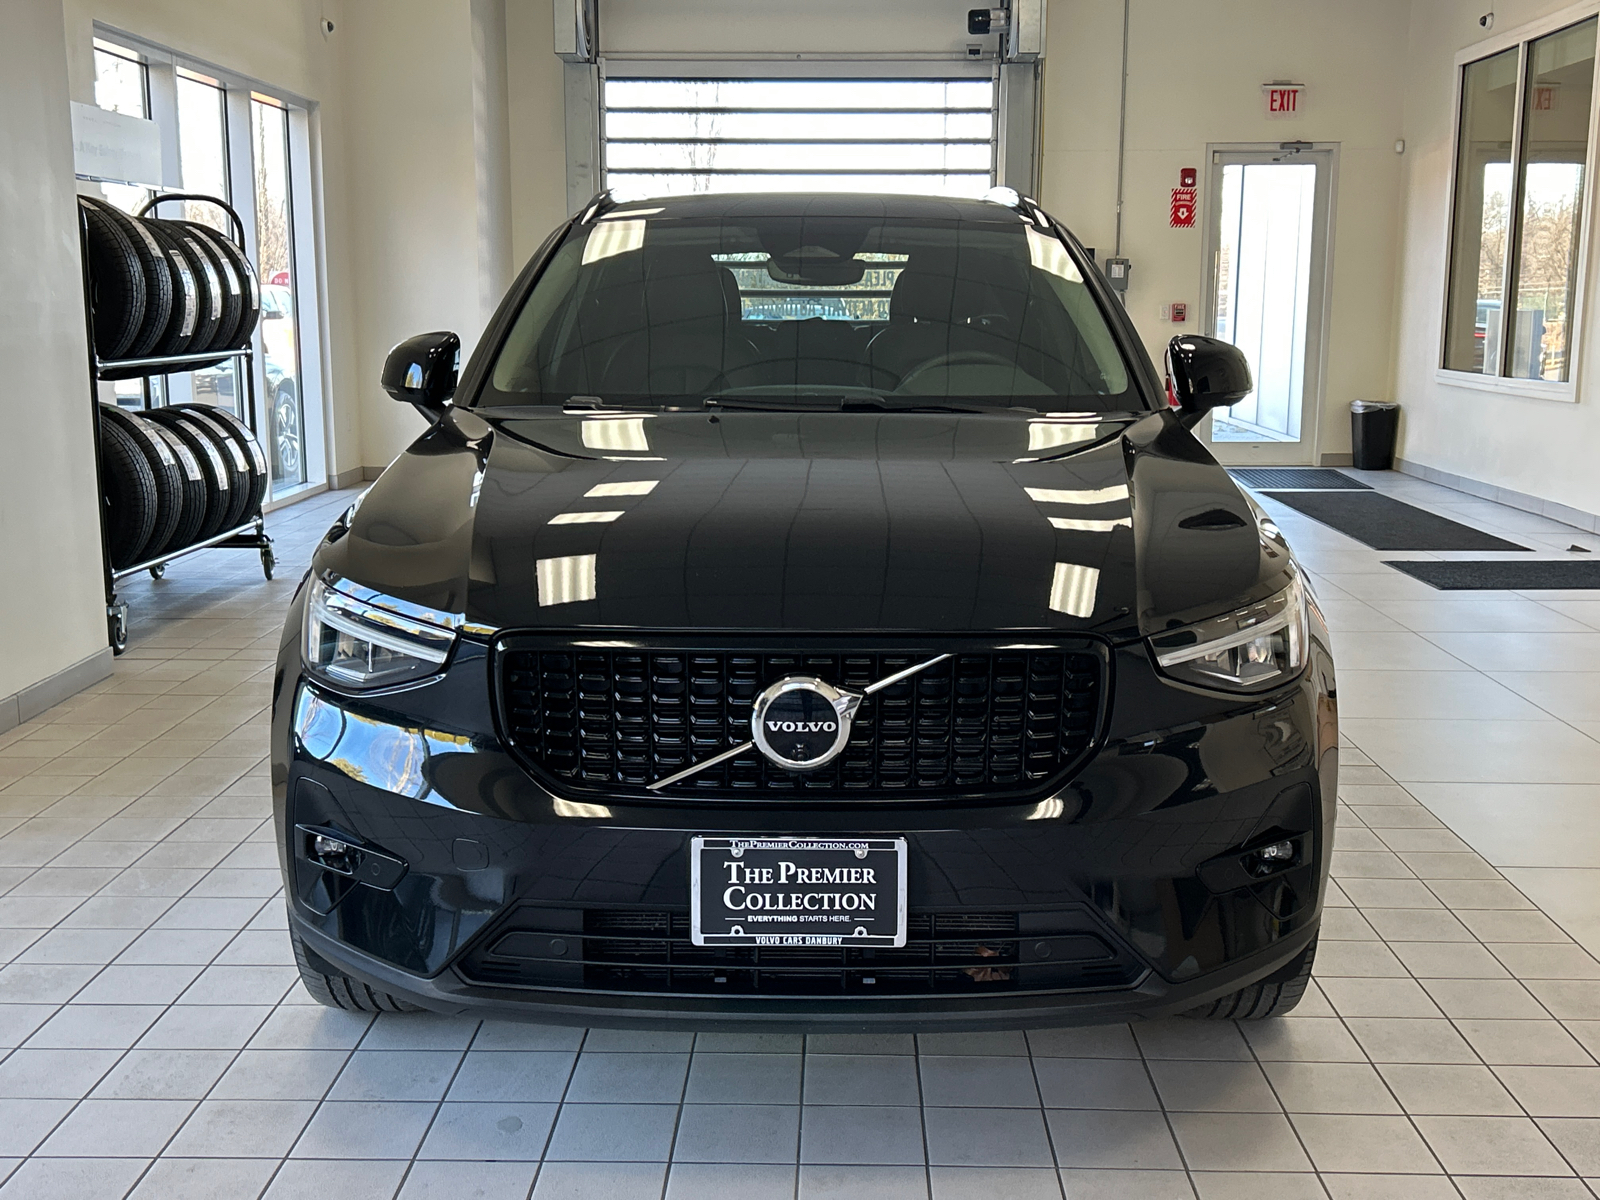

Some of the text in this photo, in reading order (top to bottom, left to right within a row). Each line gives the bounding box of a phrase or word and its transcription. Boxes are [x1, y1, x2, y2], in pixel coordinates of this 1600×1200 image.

[1270, 90, 1298, 112] EXIT
[766, 721, 837, 732] VOLVO
[723, 861, 876, 884] THE PREMIER
[723, 886, 876, 910] COLLECTION
[755, 936, 842, 945] VOLVO CARS DANBURY
